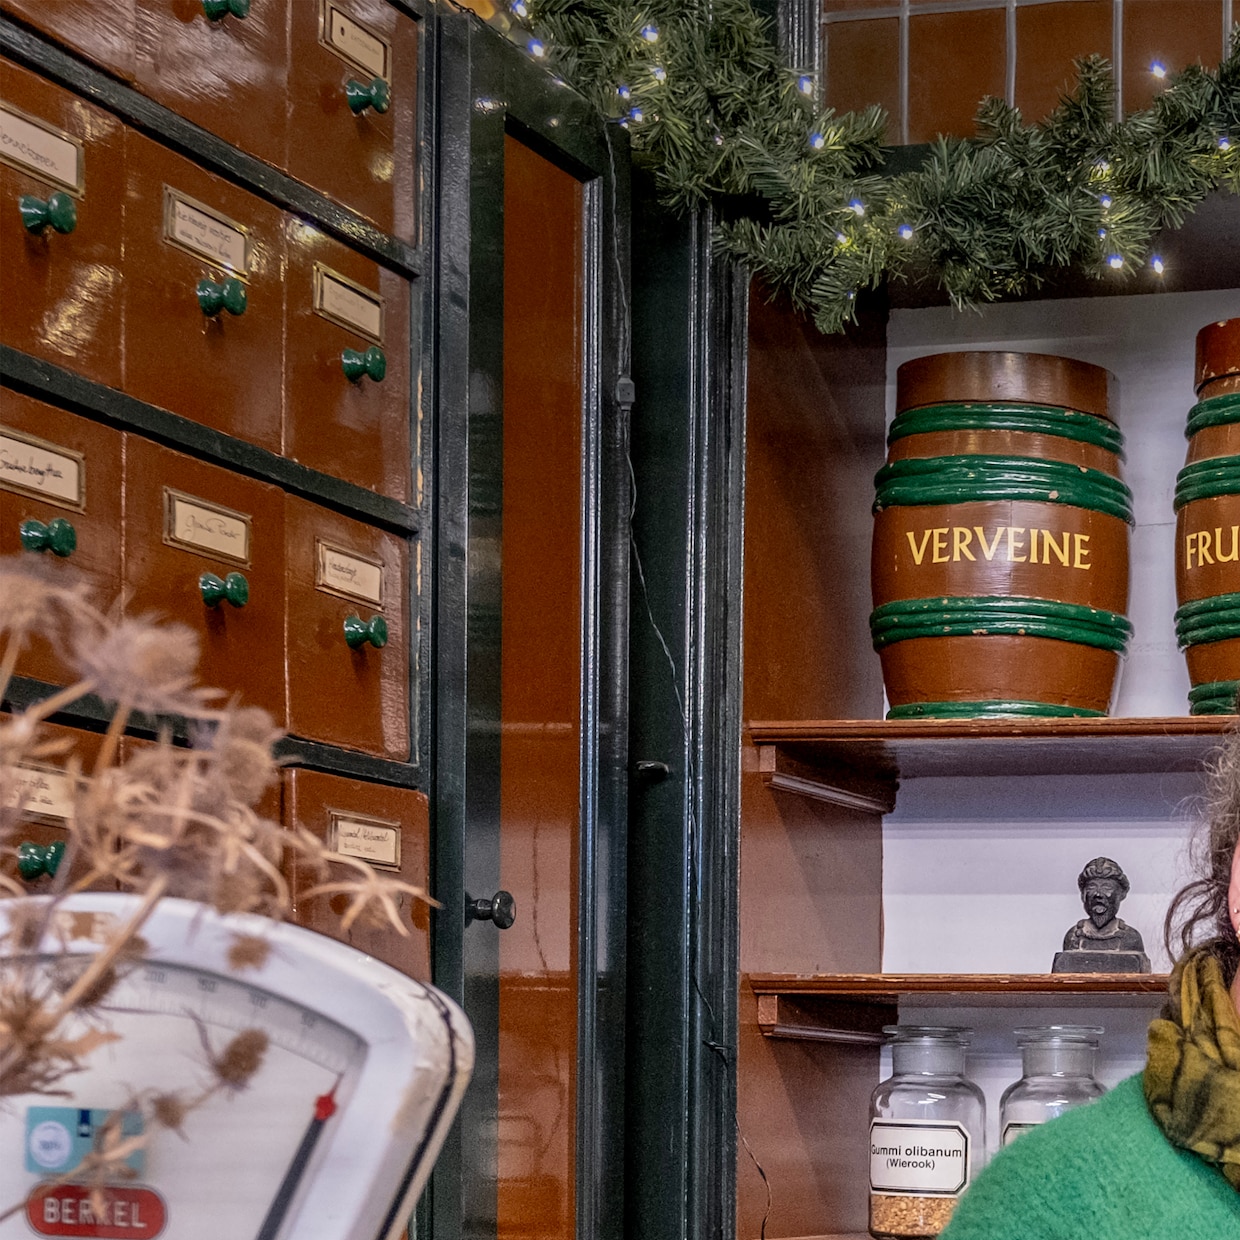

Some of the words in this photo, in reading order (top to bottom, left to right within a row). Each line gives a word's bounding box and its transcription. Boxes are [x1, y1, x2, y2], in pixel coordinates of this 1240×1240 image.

[906, 526, 1092, 570] VERVEINE
[871, 1143, 901, 1155] Gummi
[905, 1145, 962, 1158] olibanum
[886, 1158, 935, 1171] (Wierook)
